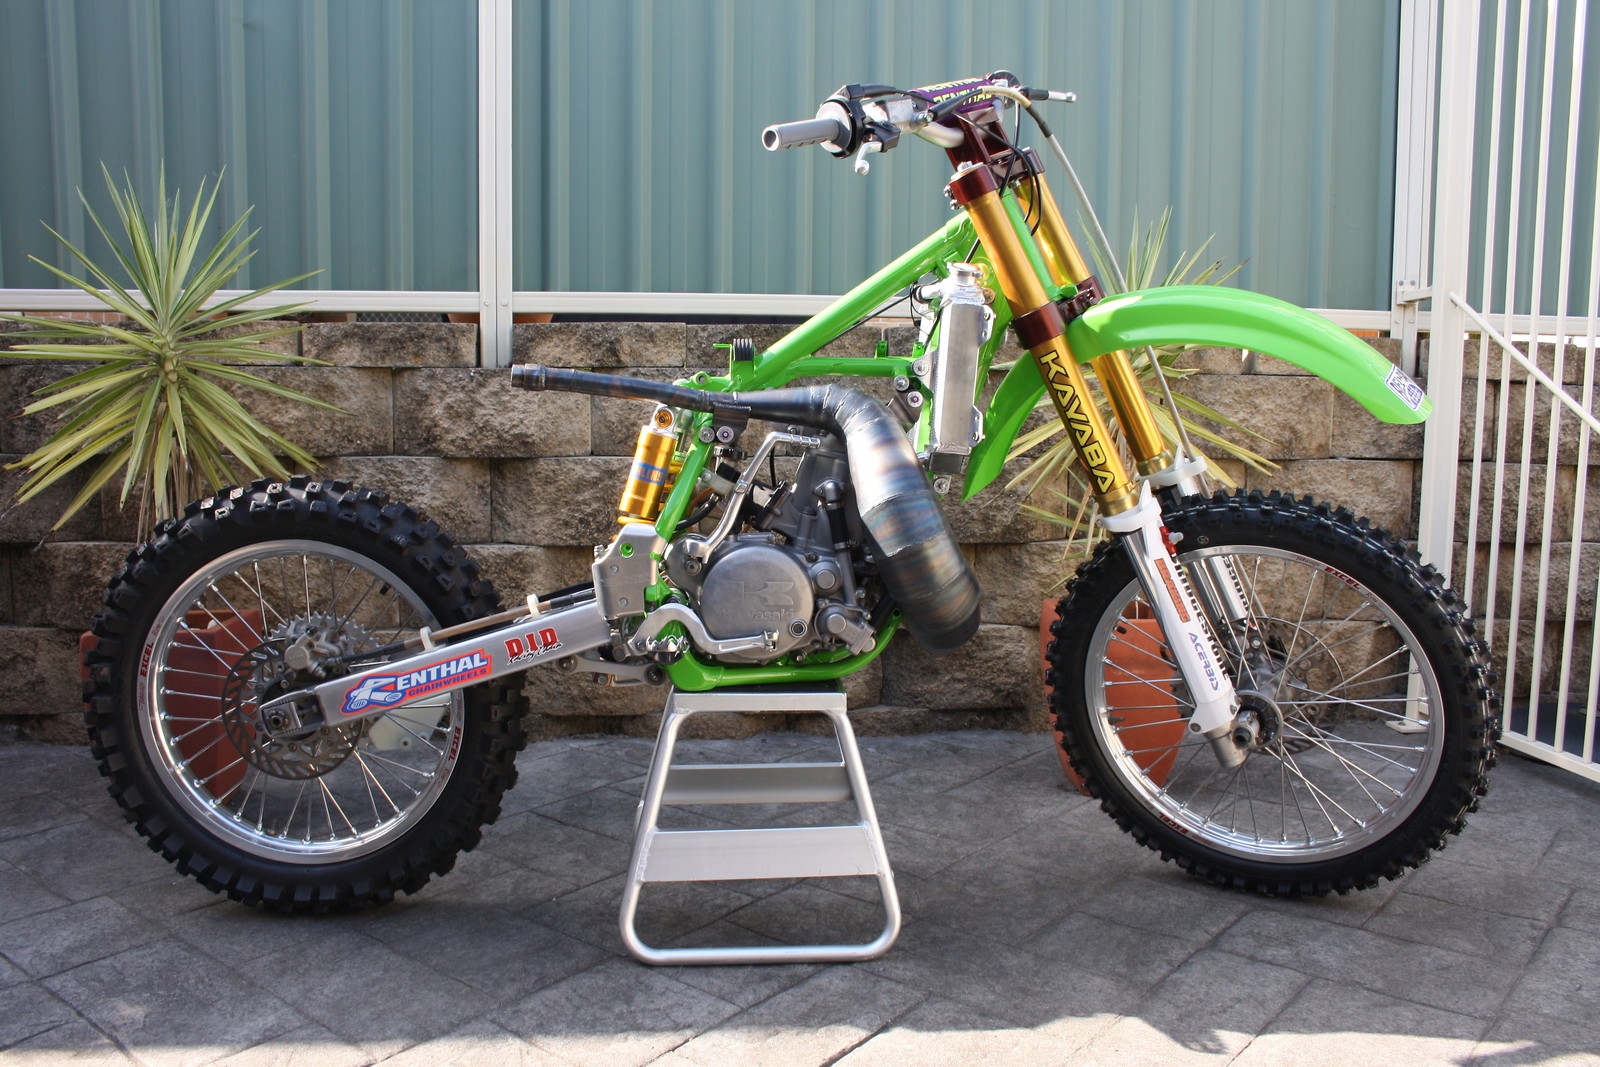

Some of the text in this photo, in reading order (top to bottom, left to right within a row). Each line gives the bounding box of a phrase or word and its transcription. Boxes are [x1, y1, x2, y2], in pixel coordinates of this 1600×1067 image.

[1039, 350, 1115, 494] KAYABA
[1154, 558, 1191, 623] BRAKING
[1324, 567, 1360, 588] EXCEL
[141, 642, 153, 677] EXCEL
[349, 653, 488, 709] RENTHAL
[408, 667, 487, 697] CHAINWHEELS
[448, 727, 461, 761] EXCEL
[1158, 812, 1188, 835] EXCEL
